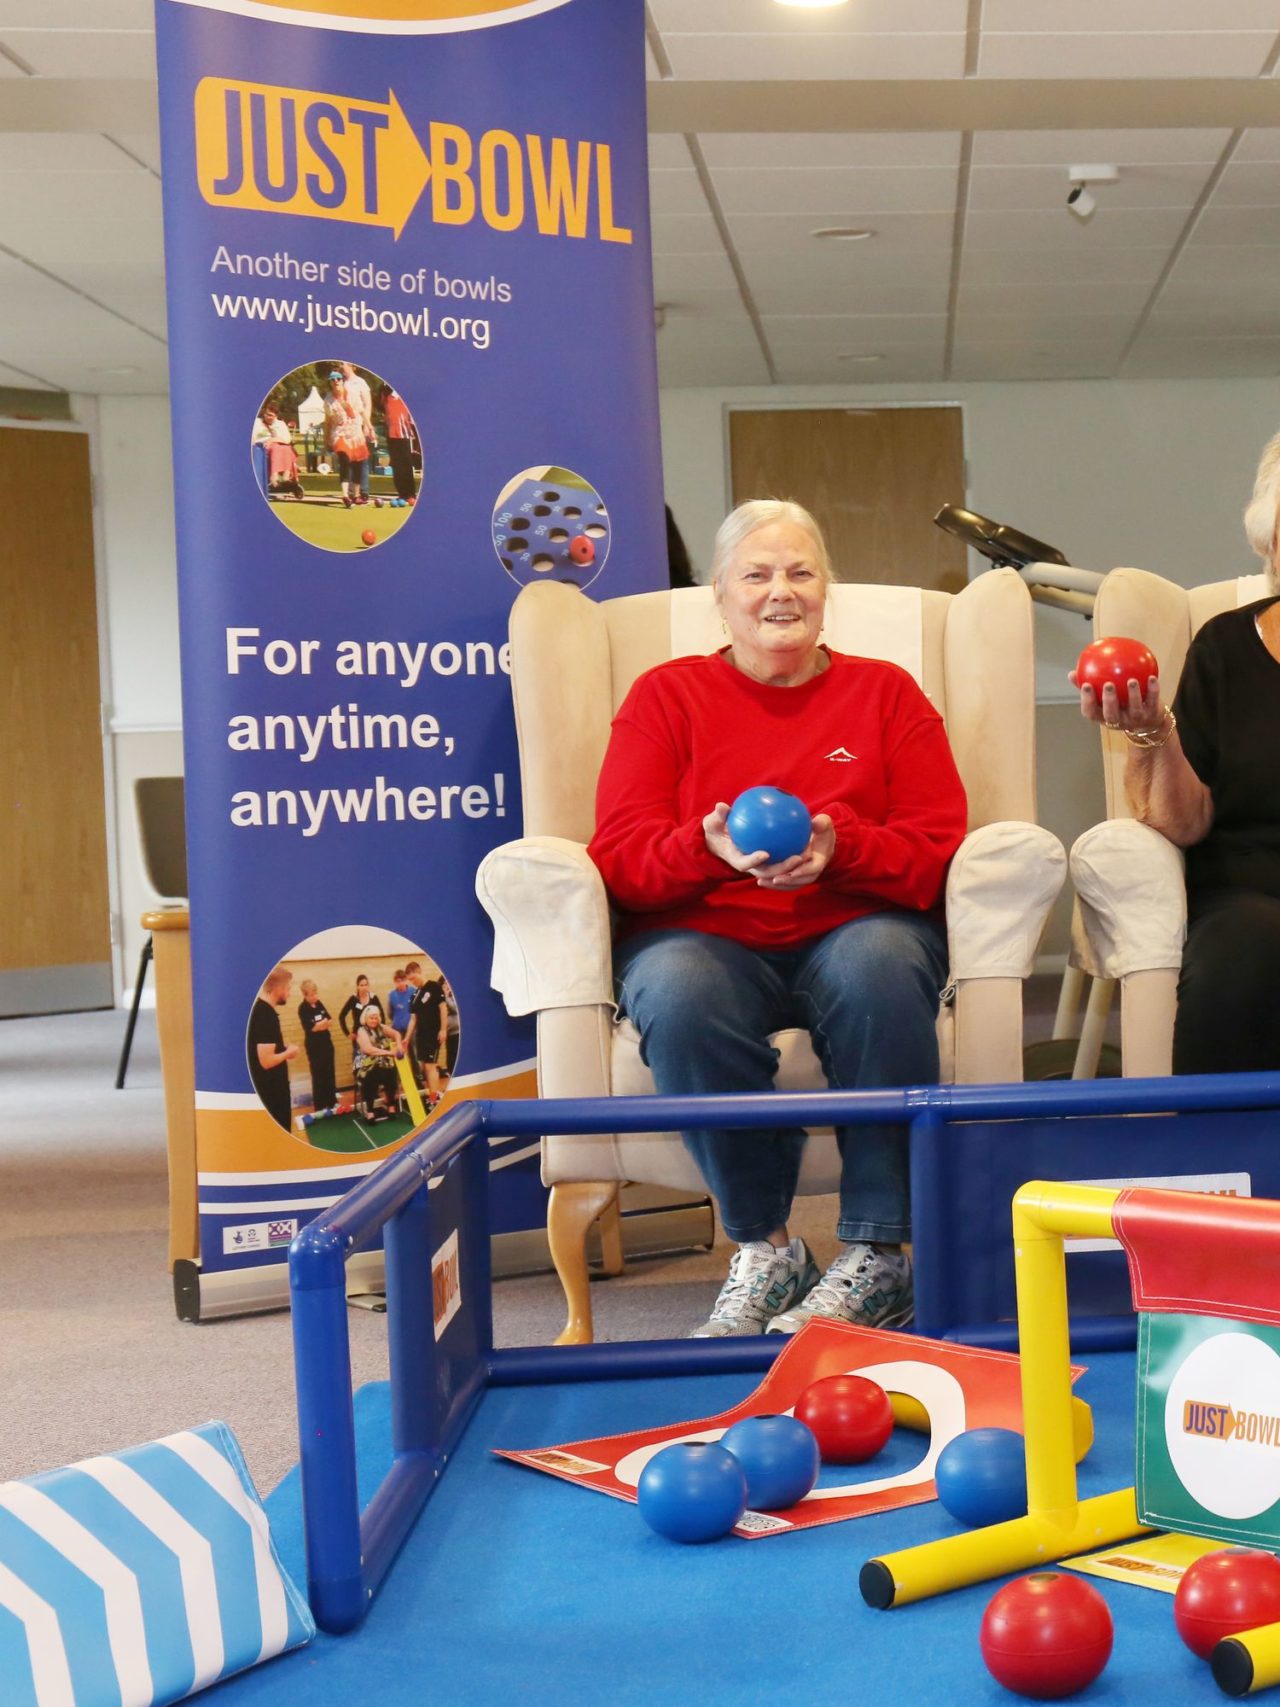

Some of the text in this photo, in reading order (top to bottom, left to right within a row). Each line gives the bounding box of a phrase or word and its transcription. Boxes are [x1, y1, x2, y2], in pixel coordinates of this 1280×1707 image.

[213, 89, 632, 244] JUST BOWL
[210, 246, 512, 302] Another side of bowls
[211, 293, 491, 349] www.justbowl.org
[494, 512, 513, 528] 100
[226, 627, 320, 675] For
[227, 703, 455, 762] anytime,
[230, 773, 506, 837] anywhere!
[1186, 1404, 1228, 1437] JUST
